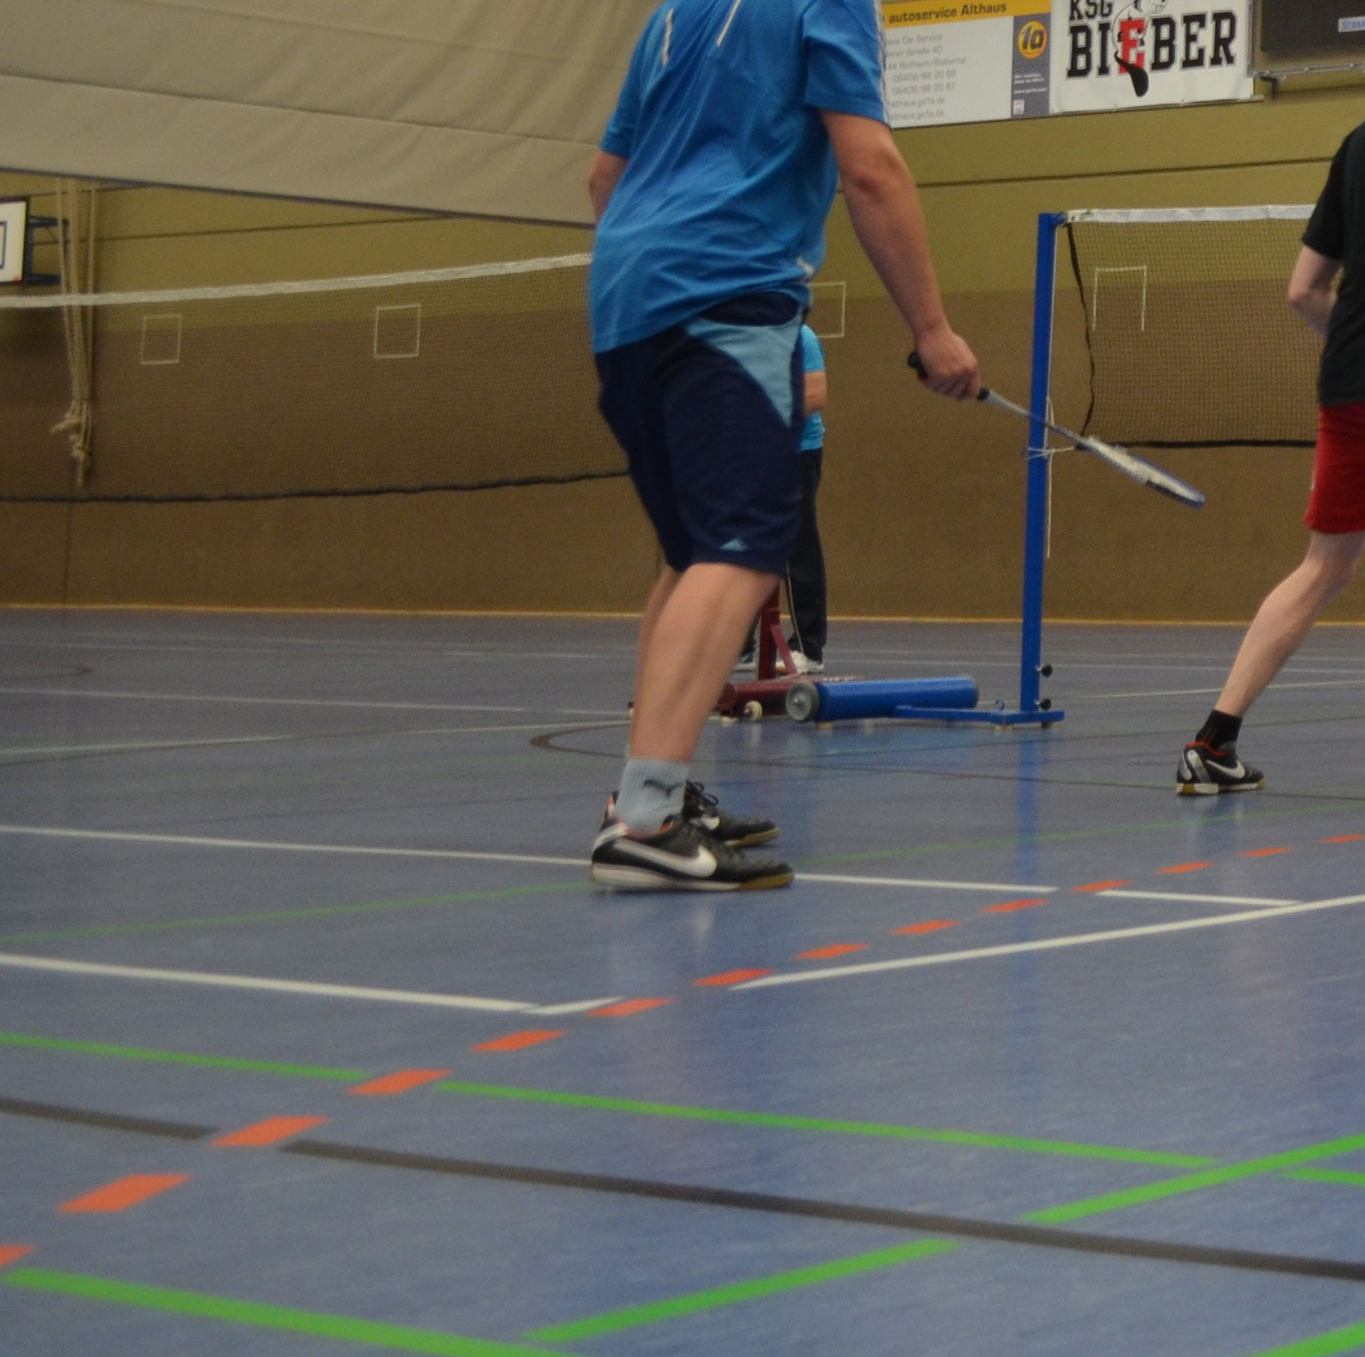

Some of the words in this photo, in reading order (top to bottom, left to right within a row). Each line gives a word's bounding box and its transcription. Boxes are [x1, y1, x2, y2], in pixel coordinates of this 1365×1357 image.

[889, 7, 957, 23] autoservice
[961, 3, 1007, 16] Althaus
[1022, 25, 1045, 50] 1a
[1067, 11, 1236, 77] BIEBER
